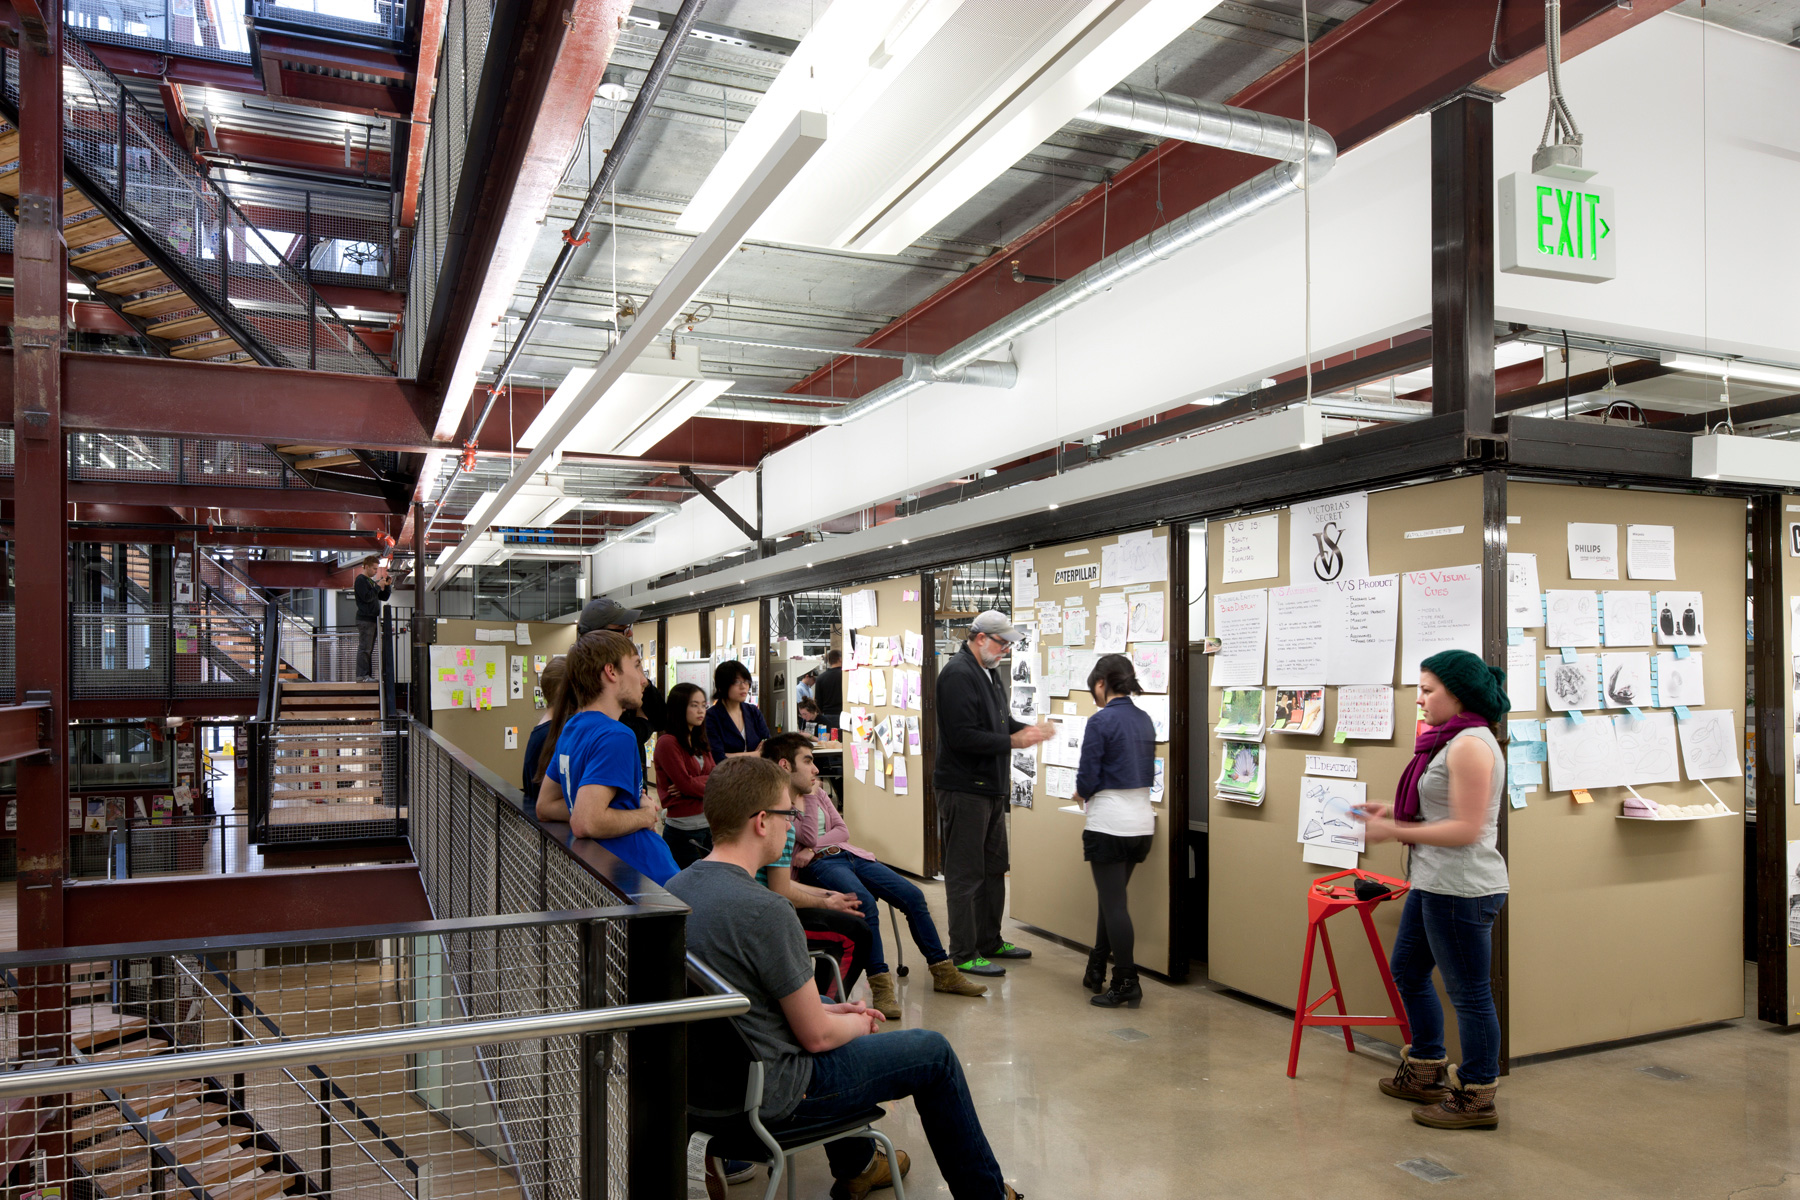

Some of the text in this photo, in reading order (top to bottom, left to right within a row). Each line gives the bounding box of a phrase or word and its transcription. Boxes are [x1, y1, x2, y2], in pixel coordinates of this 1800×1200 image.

[1537, 185, 1600, 260] EXIT
[1307, 500, 1350, 515] VICTORIA'S
[1315, 511, 1343, 524] SECRET
[1229, 521, 1245, 532] VS
[1575, 544, 1601, 553] PHILIPS
[1055, 566, 1097, 583] CATERPILLAR
[1409, 571, 1471, 585] VS VISUAL
[1336, 579, 1393, 592] VS PRODUCT
[1424, 586, 1449, 597] CUES
[1309, 756, 1356, 772] IDEATION
